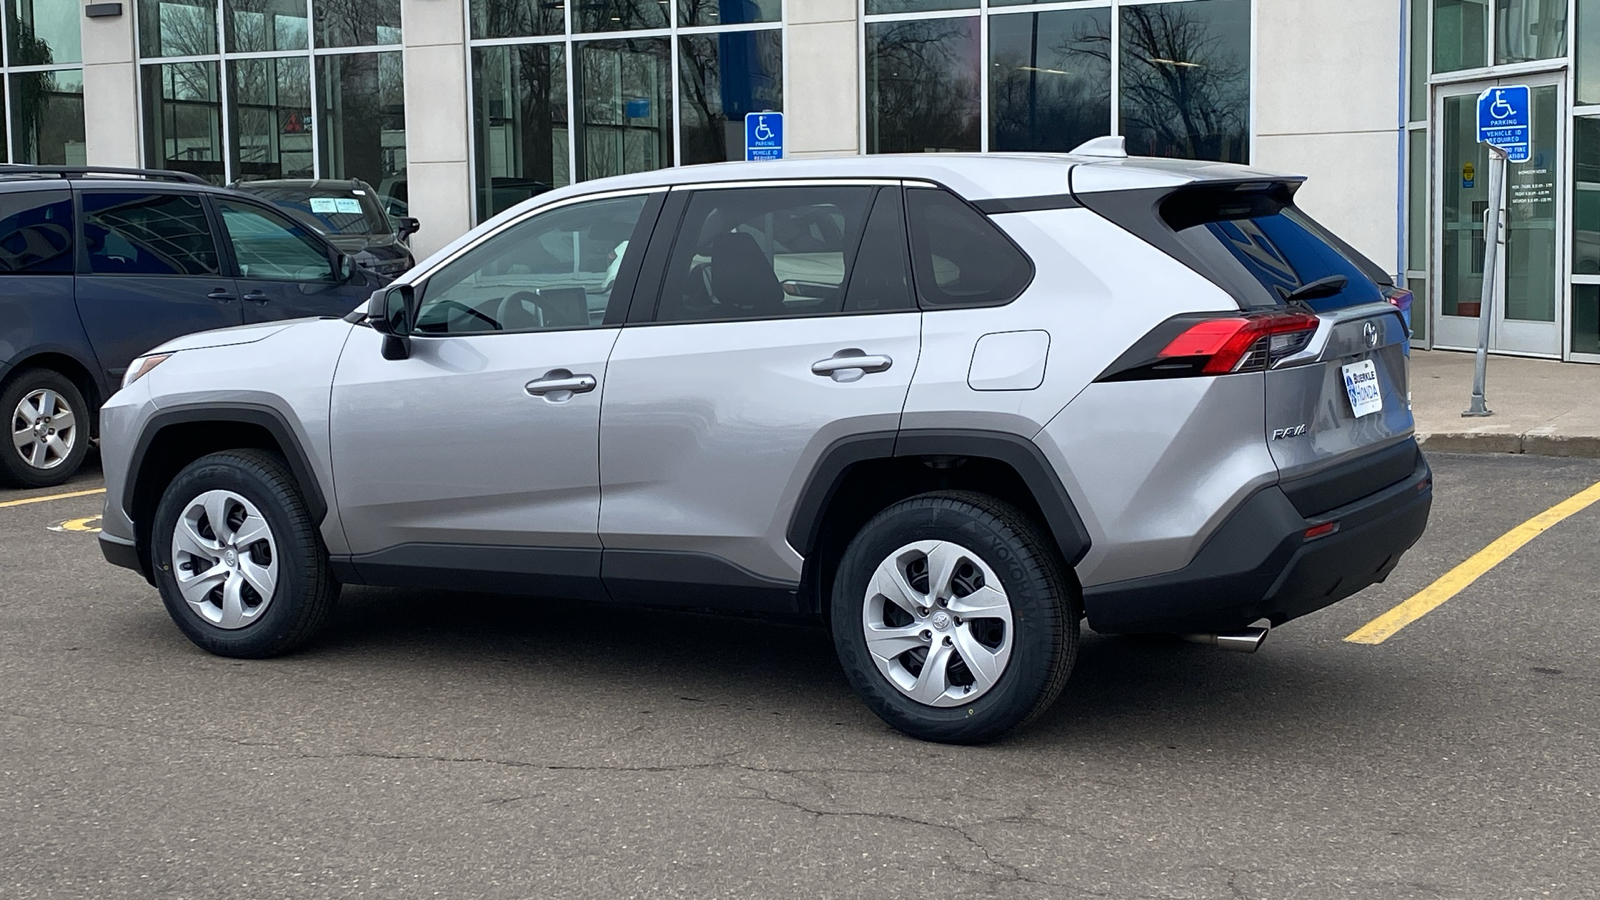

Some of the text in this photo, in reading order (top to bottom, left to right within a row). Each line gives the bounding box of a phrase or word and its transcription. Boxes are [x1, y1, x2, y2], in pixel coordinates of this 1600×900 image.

[1353, 371, 1376, 384] BUERKLE
[1355, 384, 1378, 401] HONDA
[989, 535, 1038, 635] YOKOHAMA
